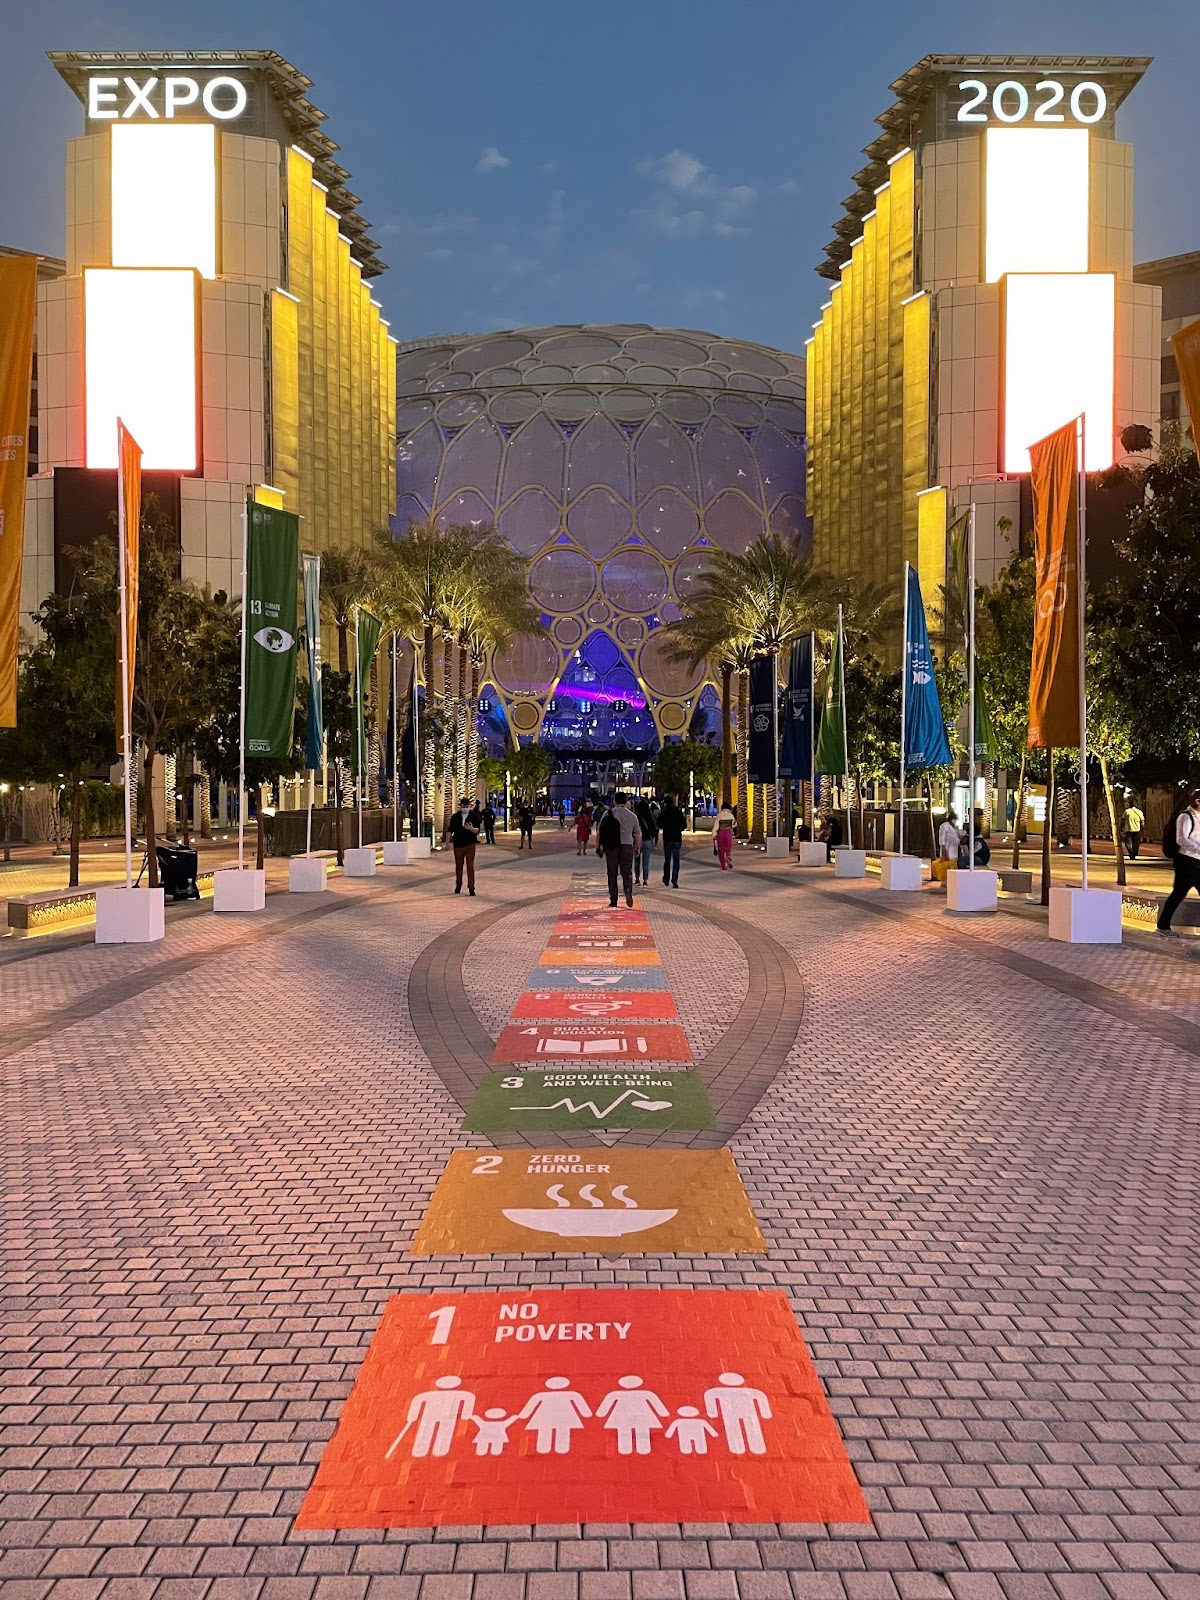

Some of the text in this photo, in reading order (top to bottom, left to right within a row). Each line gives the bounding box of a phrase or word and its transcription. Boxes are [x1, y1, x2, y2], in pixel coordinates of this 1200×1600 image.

[88, 76, 247, 120] EXPO
[956, 79, 1107, 124] 2020
[250, 600, 262, 615] 13
[519, 1027, 539, 1035] 4
[500, 1076, 525, 1089] 3
[472, 1155, 504, 1175] 2
[528, 1154, 581, 1164] ZERO
[526, 1164, 611, 1174] HUNGER
[499, 1303, 539, 1320] NO
[428, 1306, 457, 1345] 1
[494, 1322, 632, 1342] POVERTY
